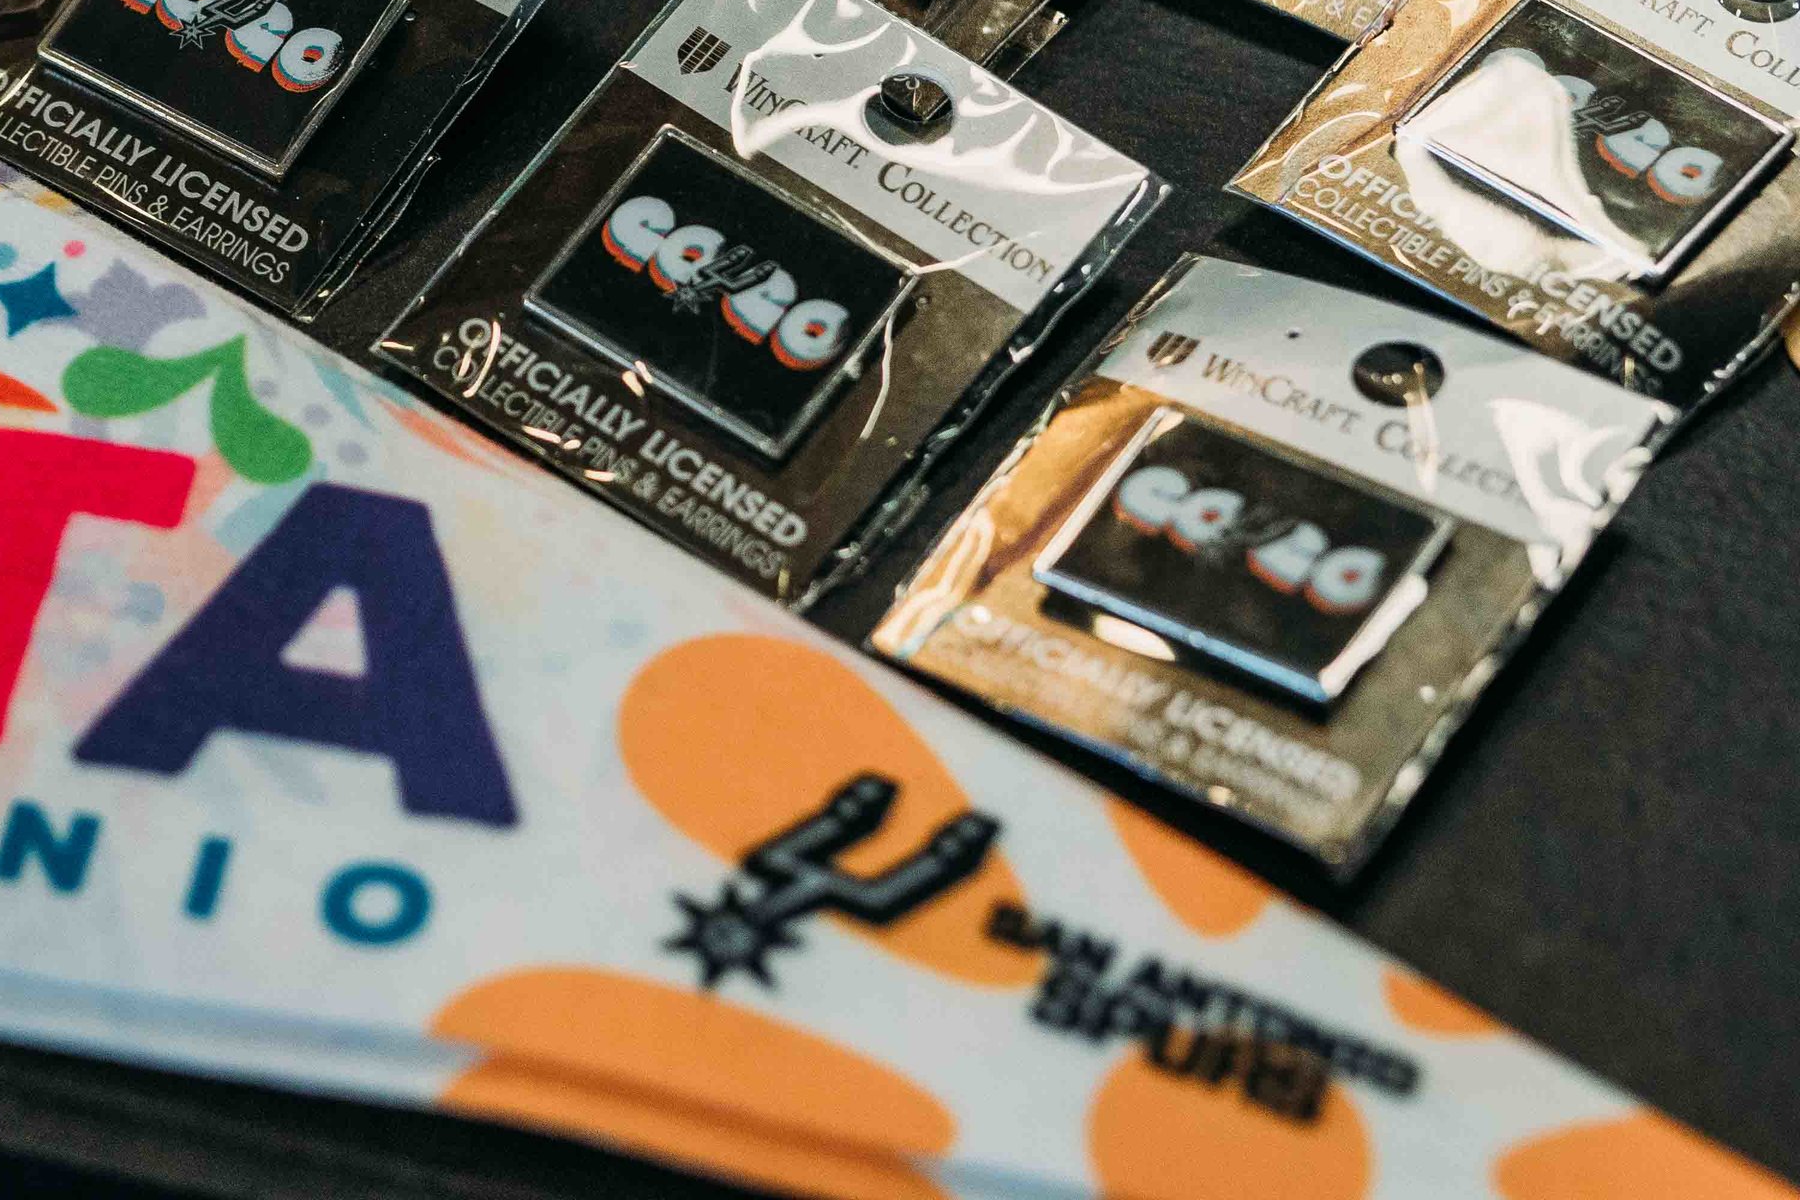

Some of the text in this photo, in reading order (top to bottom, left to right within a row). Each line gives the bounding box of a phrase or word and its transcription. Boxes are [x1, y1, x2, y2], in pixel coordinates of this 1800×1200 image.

[92, 164, 150, 205] PINS
[146, 193, 169, 220] &
[169, 206, 291, 284] EARRINGS
[150, 154, 310, 254] LICENSED
[1294, 176, 1452, 269] COLLECTIBLE
[1446, 256, 1511, 298] PINS
[1522, 259, 1684, 374] ICENSED
[457, 316, 809, 548] OFFICIALLY LICENSED
[576, 436, 640, 485] PINS
[632, 471, 662, 500] &
[655, 483, 788, 580] EARRINGS
